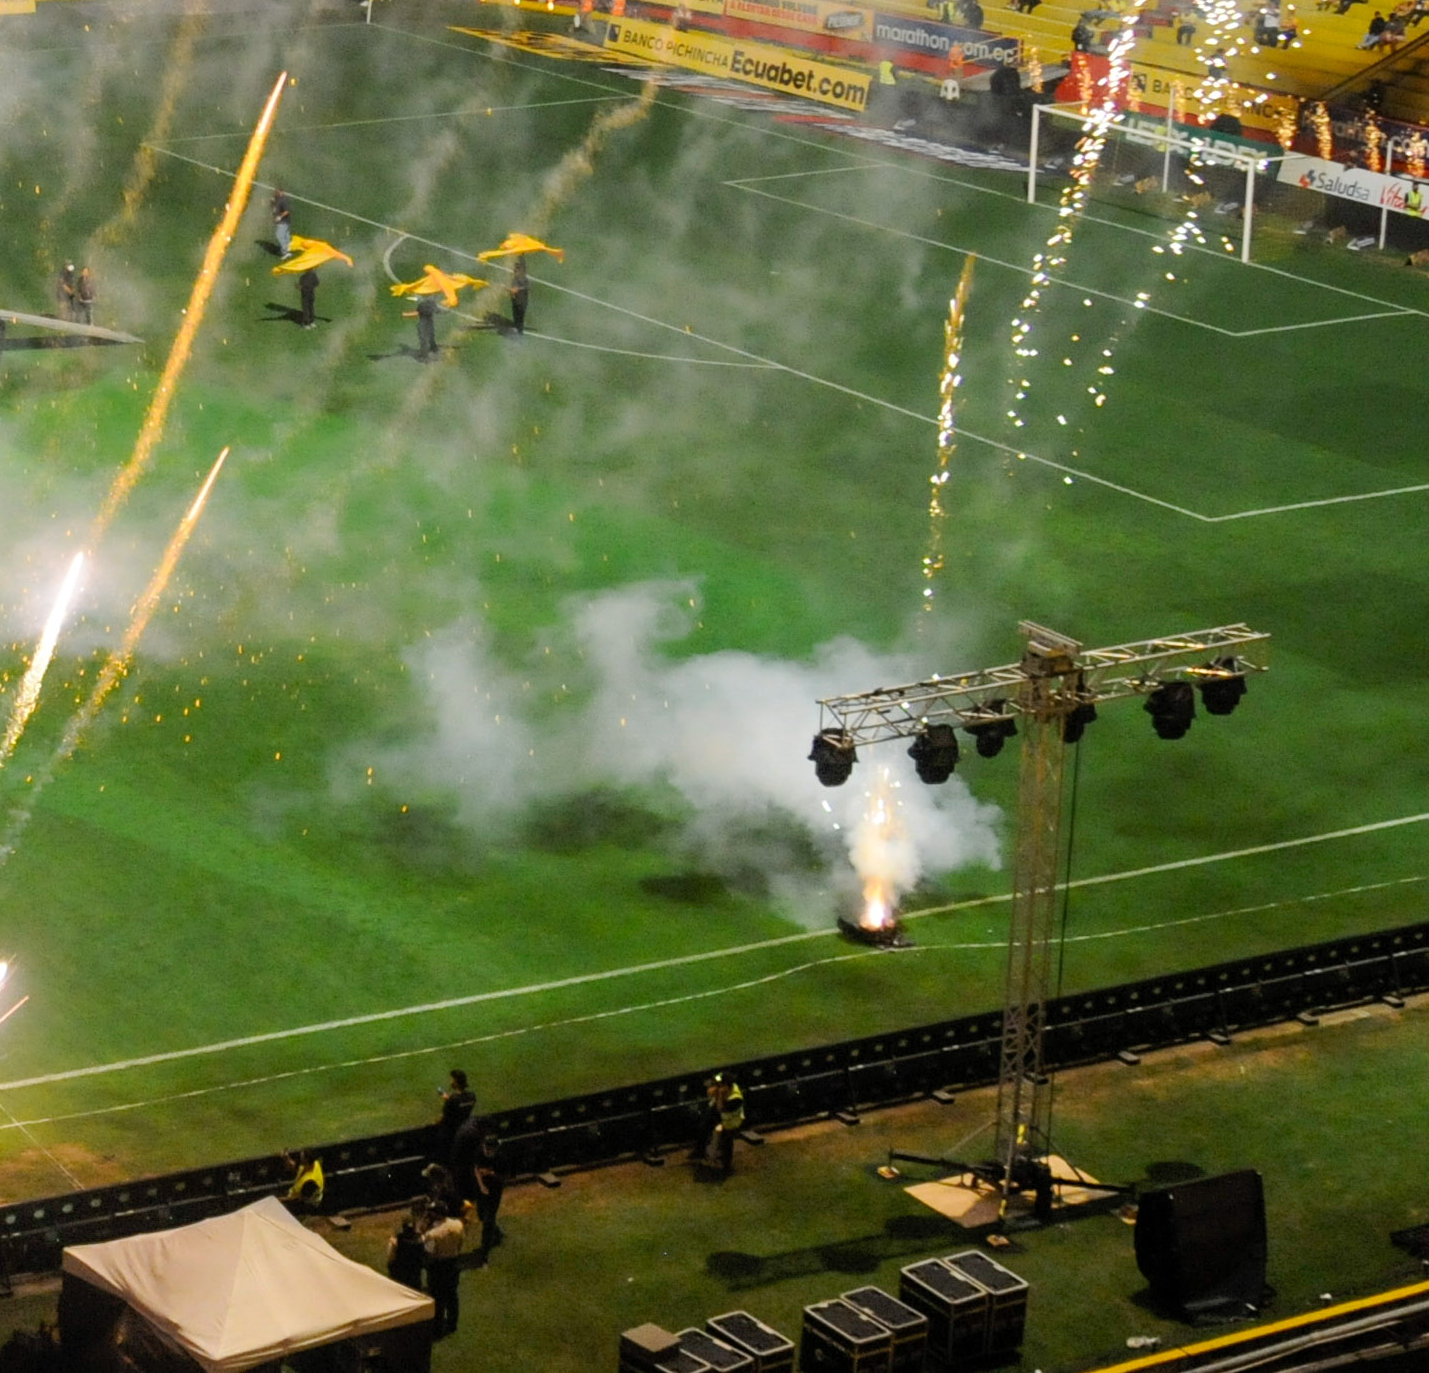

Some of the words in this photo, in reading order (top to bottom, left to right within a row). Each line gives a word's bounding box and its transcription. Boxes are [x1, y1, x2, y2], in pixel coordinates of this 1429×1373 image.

[876, 24, 1014, 63] marathonom.ec
[624, 31, 662, 50] BANCO
[666, 43, 728, 67] PICHINCHA
[731, 50, 865, 105] Ecuabet.com
[1317, 173, 1370, 201] Saludsa
